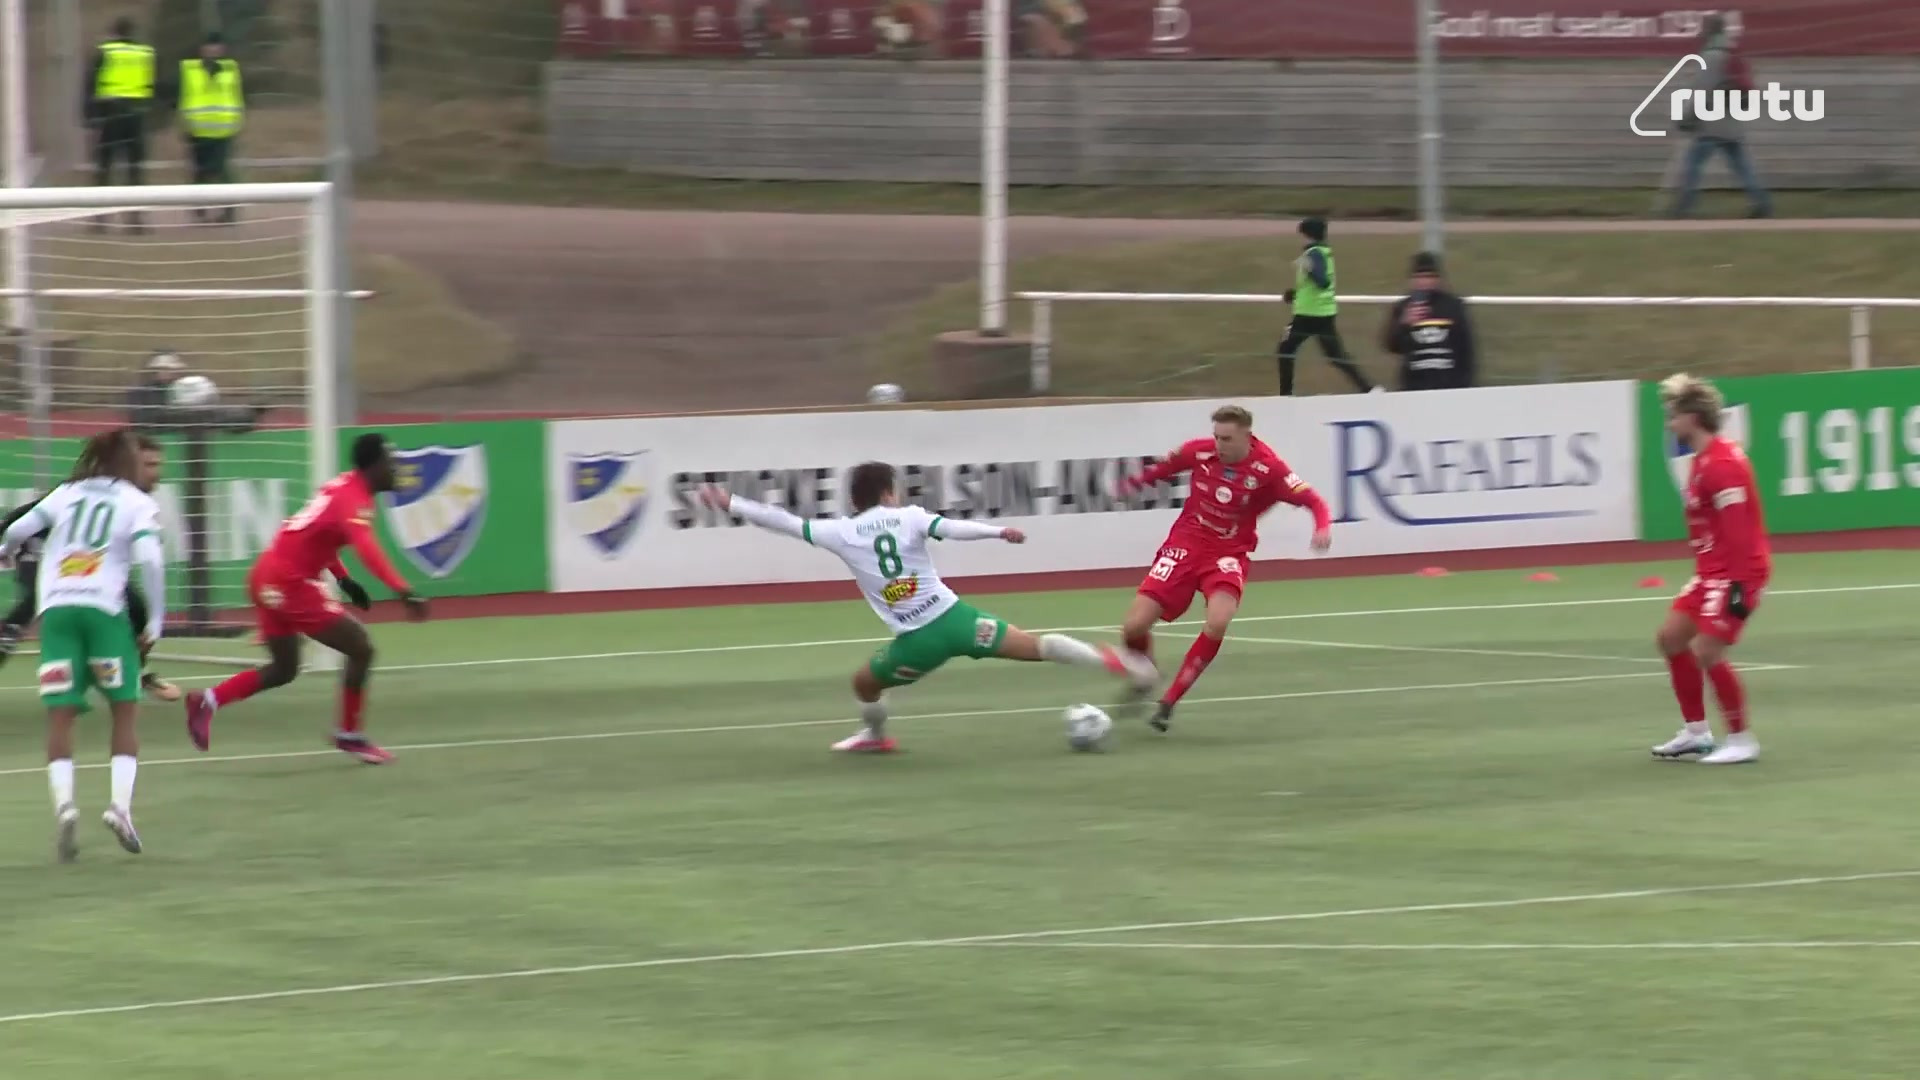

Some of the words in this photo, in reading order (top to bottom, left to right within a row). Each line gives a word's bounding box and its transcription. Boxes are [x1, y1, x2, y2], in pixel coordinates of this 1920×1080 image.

[1325, 420, 1602, 526] RAFAELS
[67, 496, 116, 548] 10
[874, 532, 903, 579] 8
